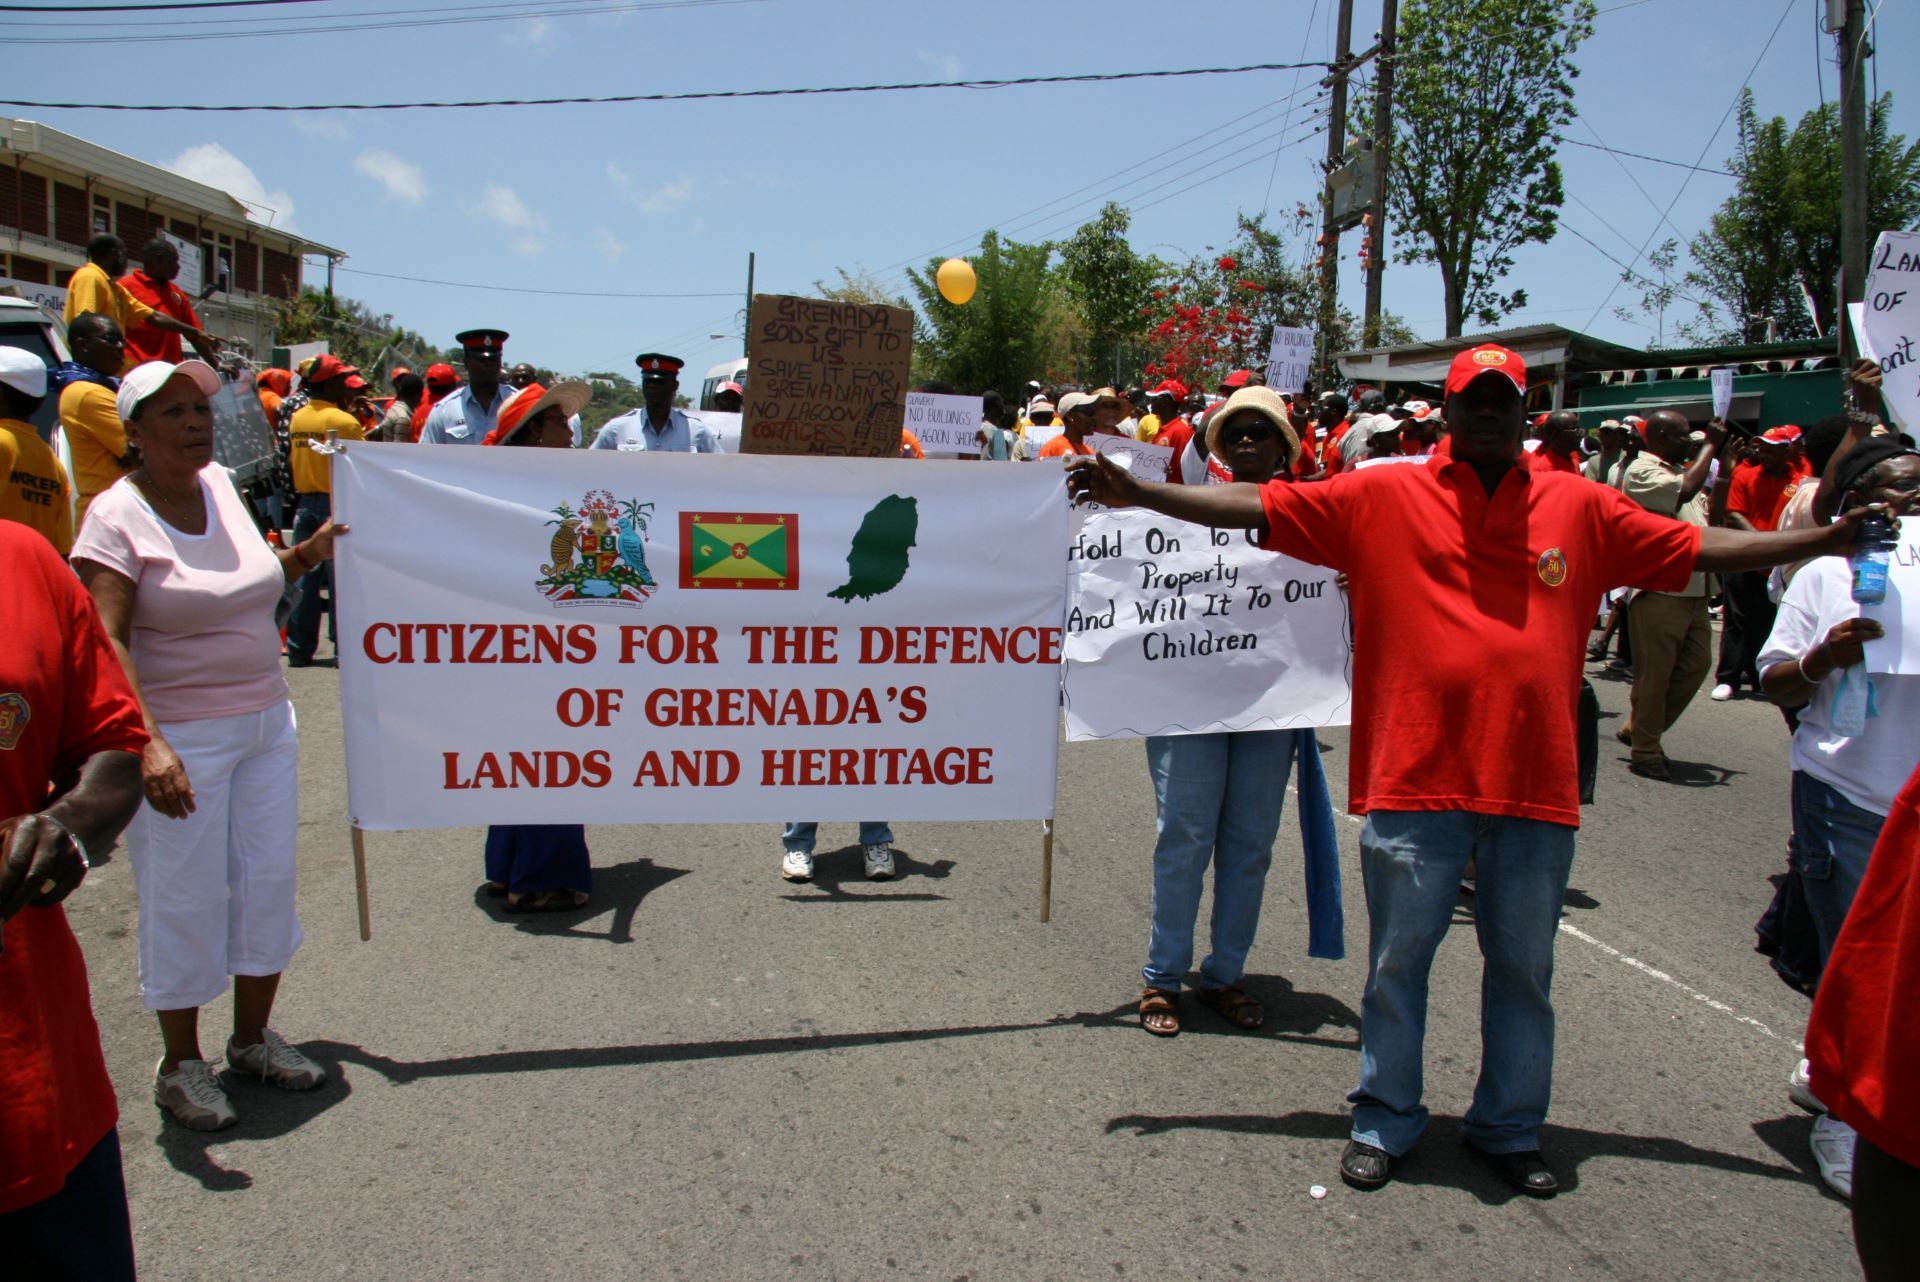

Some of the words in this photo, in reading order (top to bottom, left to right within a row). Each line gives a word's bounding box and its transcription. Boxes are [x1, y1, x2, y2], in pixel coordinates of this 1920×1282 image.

[1873, 291, 1907, 312] OF
[825, 326, 867, 348] GIFT
[873, 332, 900, 351] TO
[758, 358, 812, 381] SAVE
[823, 366, 843, 385] IT
[853, 368, 896, 390] FOR
[750, 401, 780, 419] NO
[786, 402, 862, 422] LAGOON
[909, 407, 924, 422] NO
[1145, 527, 1181, 555] On
[1138, 554, 1239, 597] Property
[1066, 599, 1115, 632] And
[1135, 597, 1187, 625] Will
[1202, 593, 1232, 617] It
[1246, 585, 1272, 610] To
[1284, 579, 1327, 603] Our
[363, 622, 597, 664] CITIZENS
[619, 624, 719, 664] FOR
[741, 625, 838, 664] THE
[859, 626, 1062, 664] DEFENCE
[1142, 629, 1257, 661] Children
[556, 687, 623, 727] OF
[645, 685, 927, 727] GRENADA'S
[442, 750, 612, 789] LANDS
[633, 750, 740, 787] AND
[760, 747, 994, 786] HERITAGE
